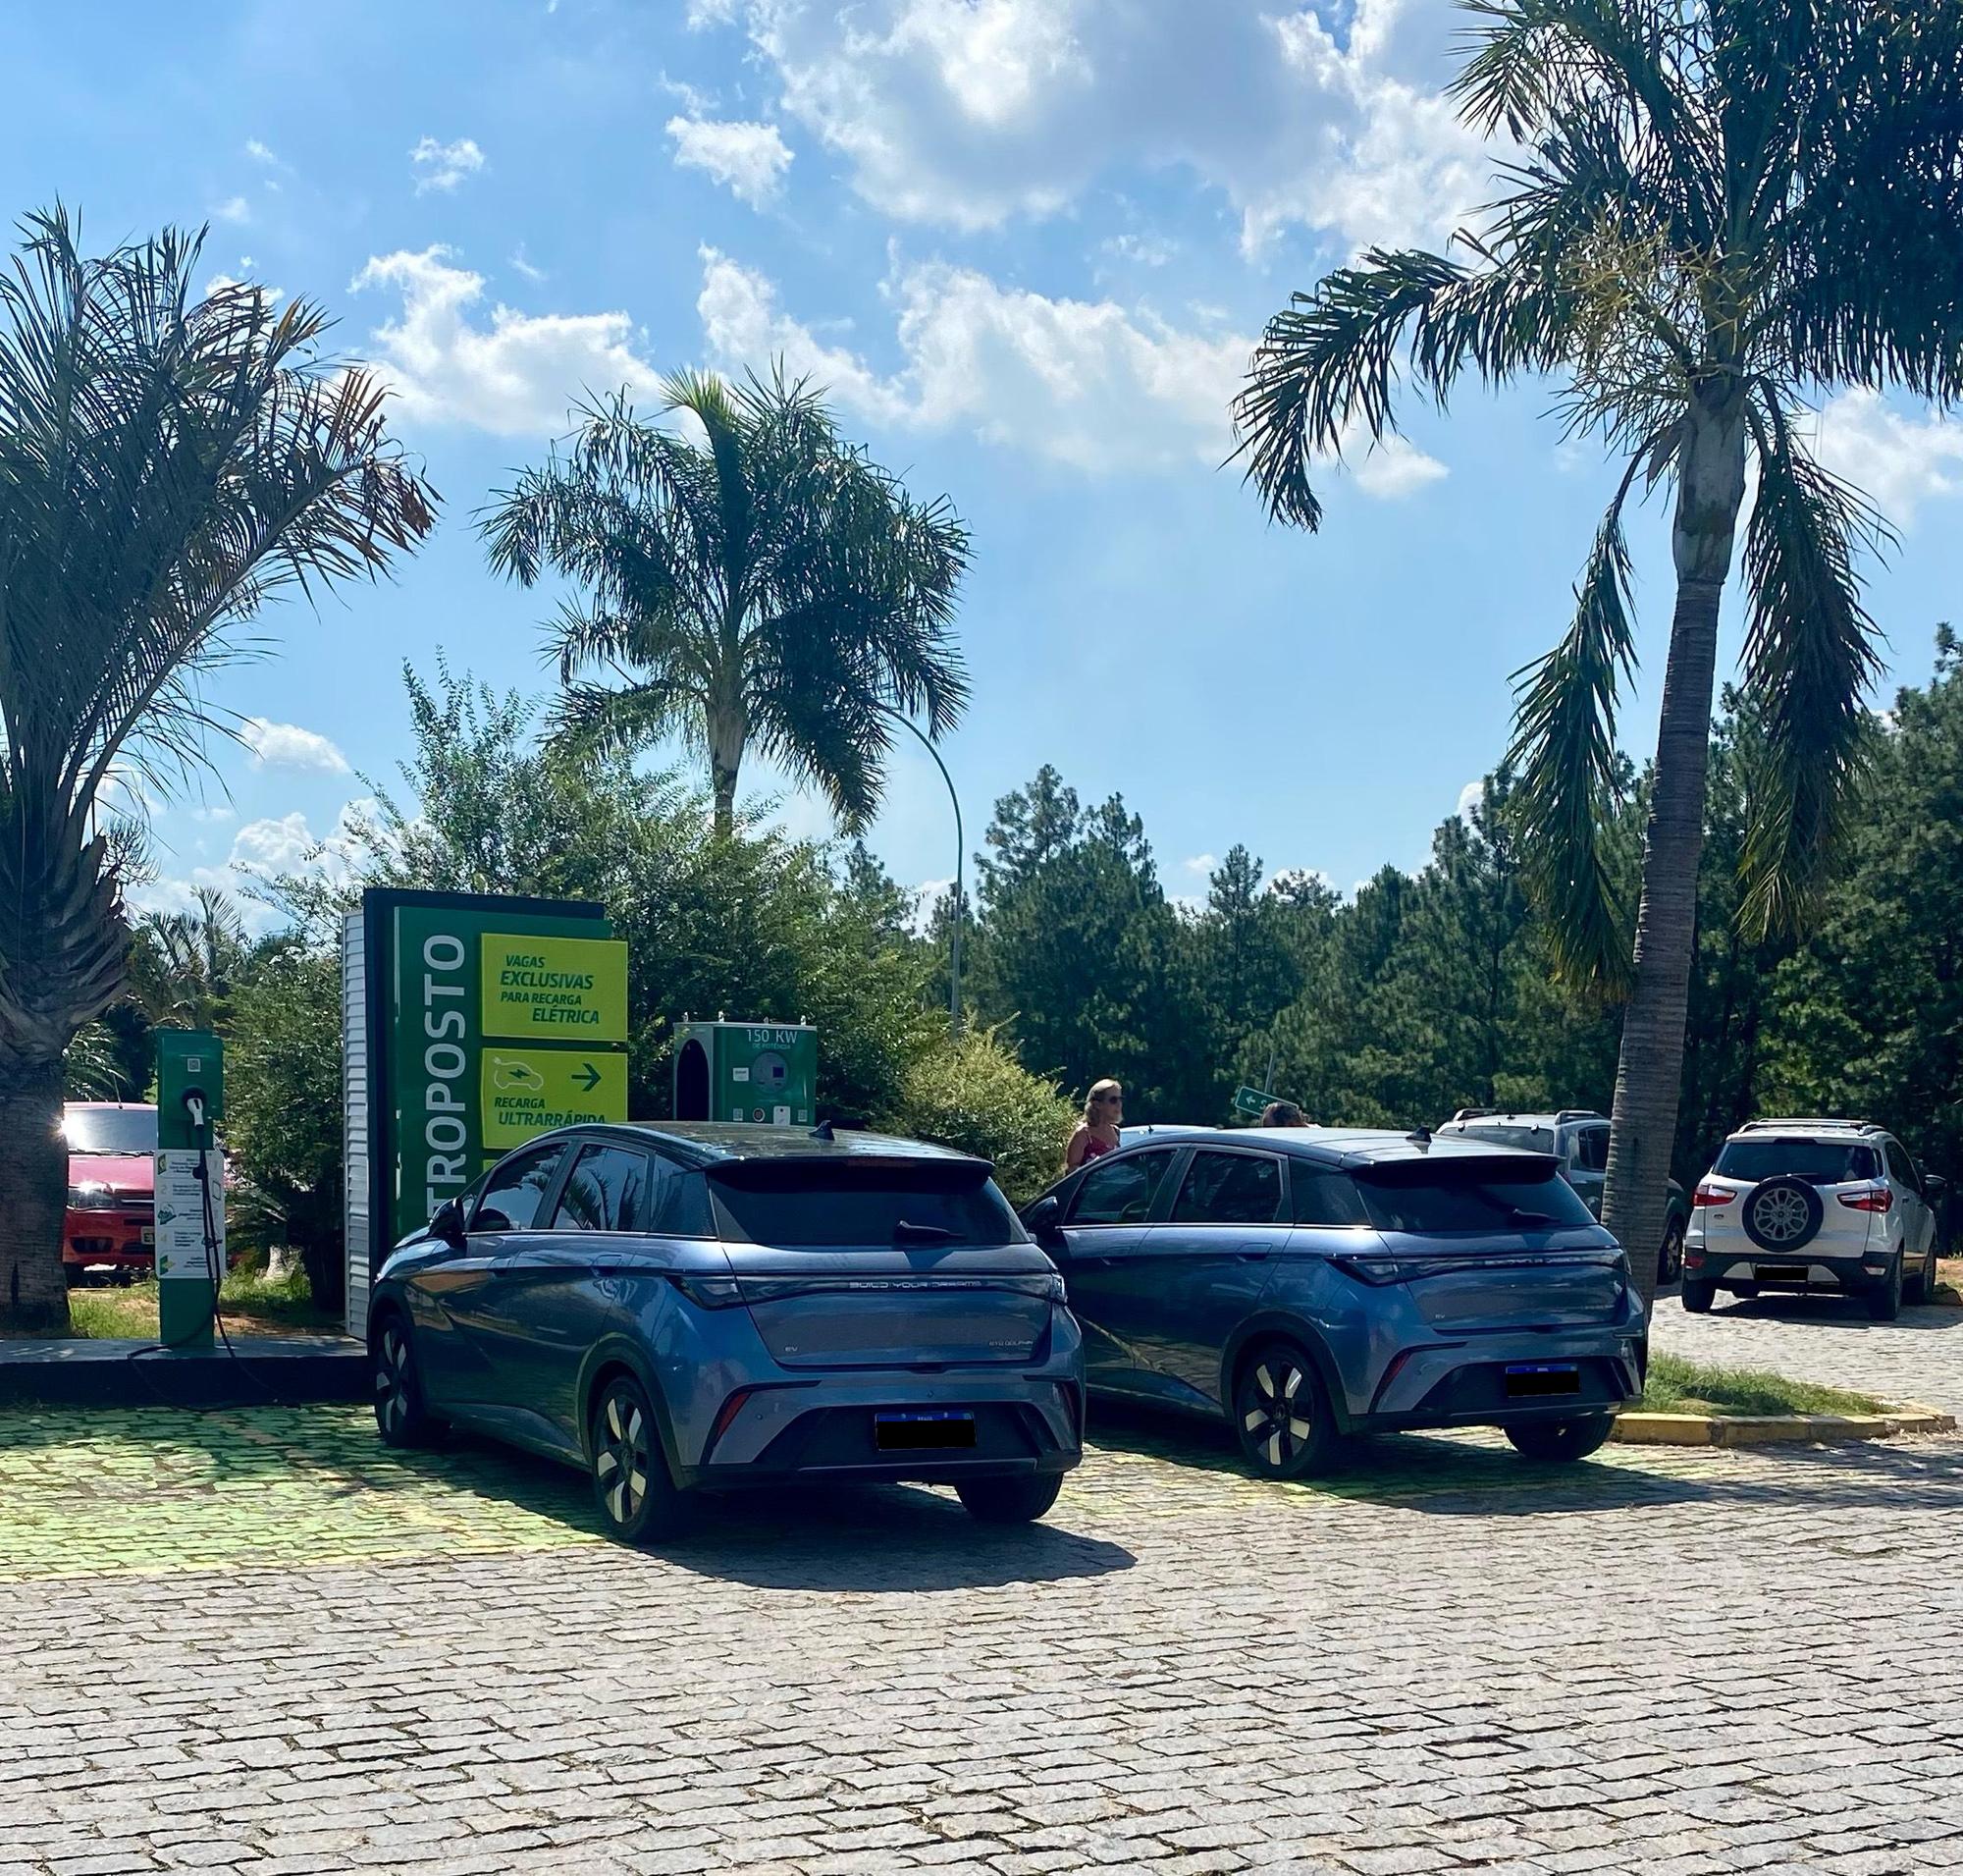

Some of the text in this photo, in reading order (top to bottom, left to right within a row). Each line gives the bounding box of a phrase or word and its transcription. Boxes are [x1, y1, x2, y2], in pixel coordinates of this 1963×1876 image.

[505, 954, 546, 968] VAGAS
[500, 970, 594, 990] EXCLUSIVAS
[500, 991, 582, 1006] PARA RECARGA
[532, 1004, 600, 1024] ELÉTRICA
[746, 1029, 798, 1044] 150 KW
[494, 1097, 546, 1109] RECARGA
[499, 1110, 606, 1127] ULTRARRÁPIDA
